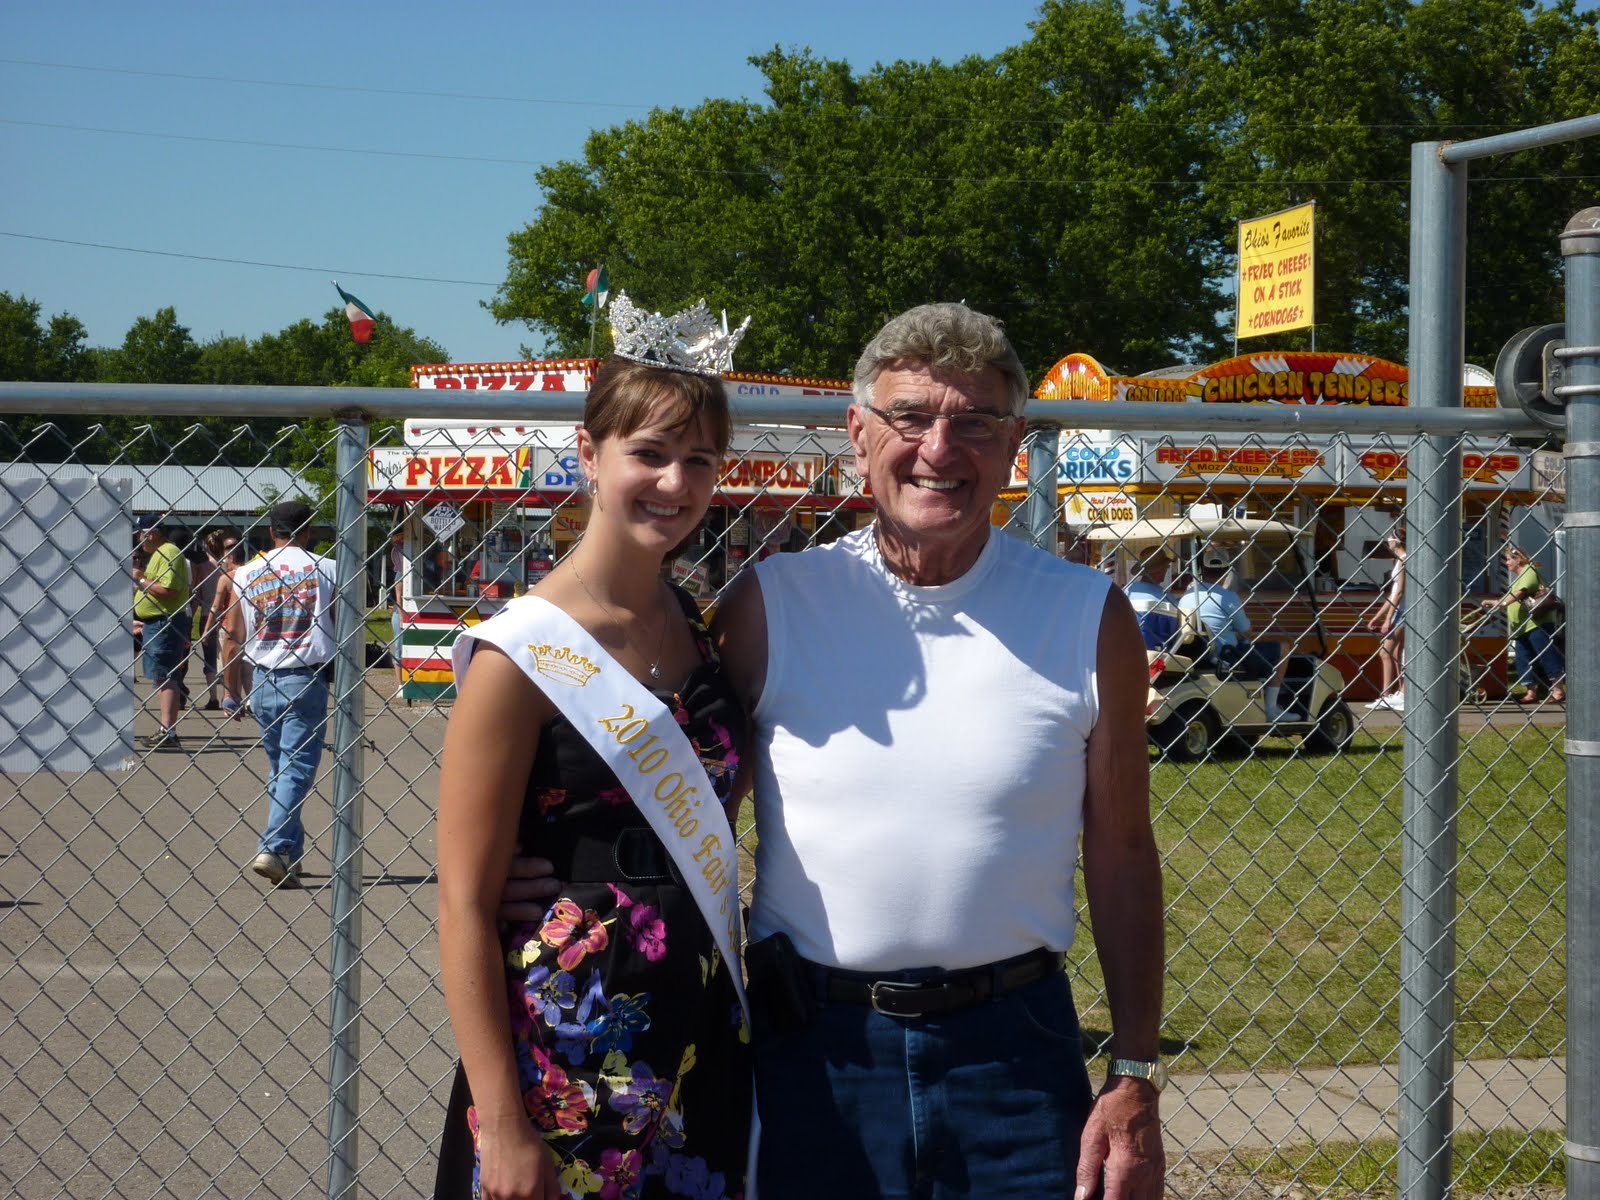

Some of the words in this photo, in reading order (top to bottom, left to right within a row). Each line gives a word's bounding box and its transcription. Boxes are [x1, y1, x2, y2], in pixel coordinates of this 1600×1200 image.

[1273, 221, 1310, 248] Favorite
[1248, 261, 1274, 282] FRIED
[1277, 253, 1307, 275] CHEESE
[1254, 286, 1265, 304] ON
[1268, 284, 1275, 301] A
[1279, 279, 1302, 299] STICK
[1203, 371, 1304, 402] CHICKEN
[1067, 447, 1120, 461] COLD
[1157, 448, 1214, 463] FRIED
[1217, 448, 1290, 463] CHEESE
[406, 457, 512, 486] PIZZA
[1088, 508, 1109, 520] CON
[1111, 507, 1134, 520] DOGS
[597, 704, 669, 774] 2010
[654, 772, 703, 838] Ohio
